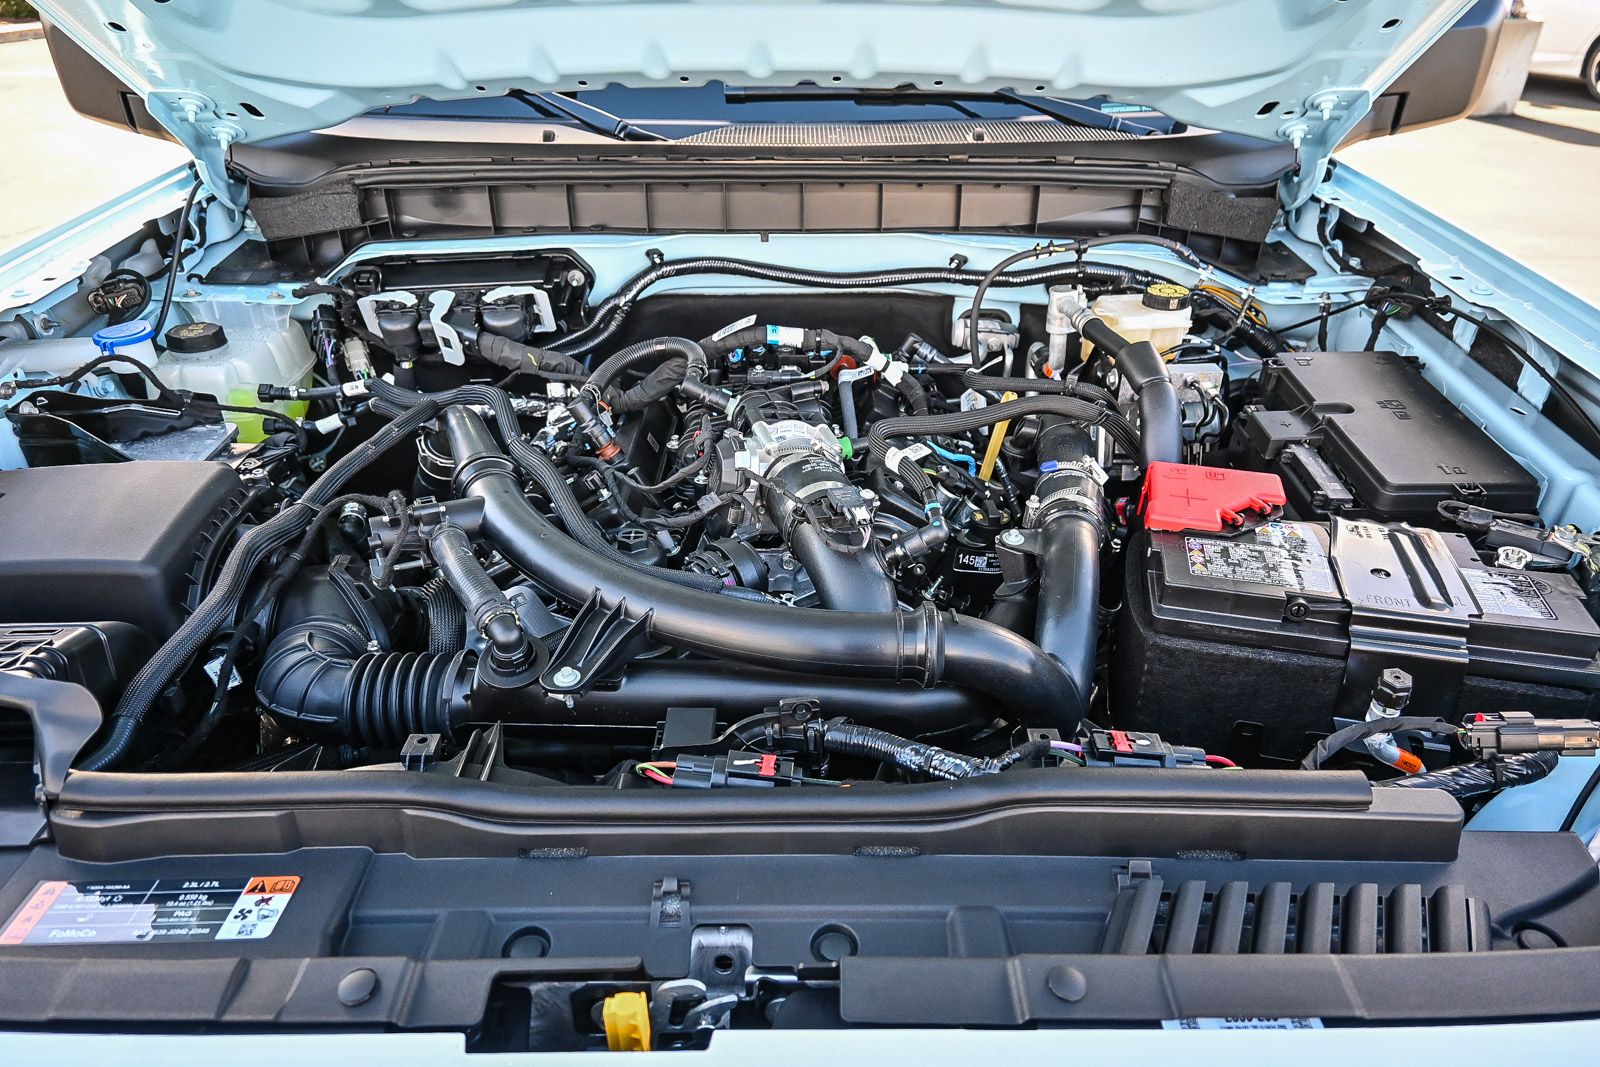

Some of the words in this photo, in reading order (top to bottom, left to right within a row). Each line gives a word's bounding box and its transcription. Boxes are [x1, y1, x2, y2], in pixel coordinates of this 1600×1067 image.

[958, 553, 976, 566] 145
[1365, 594, 1411, 608] FRONT
[48, 928, 97, 938] FoMoCo
